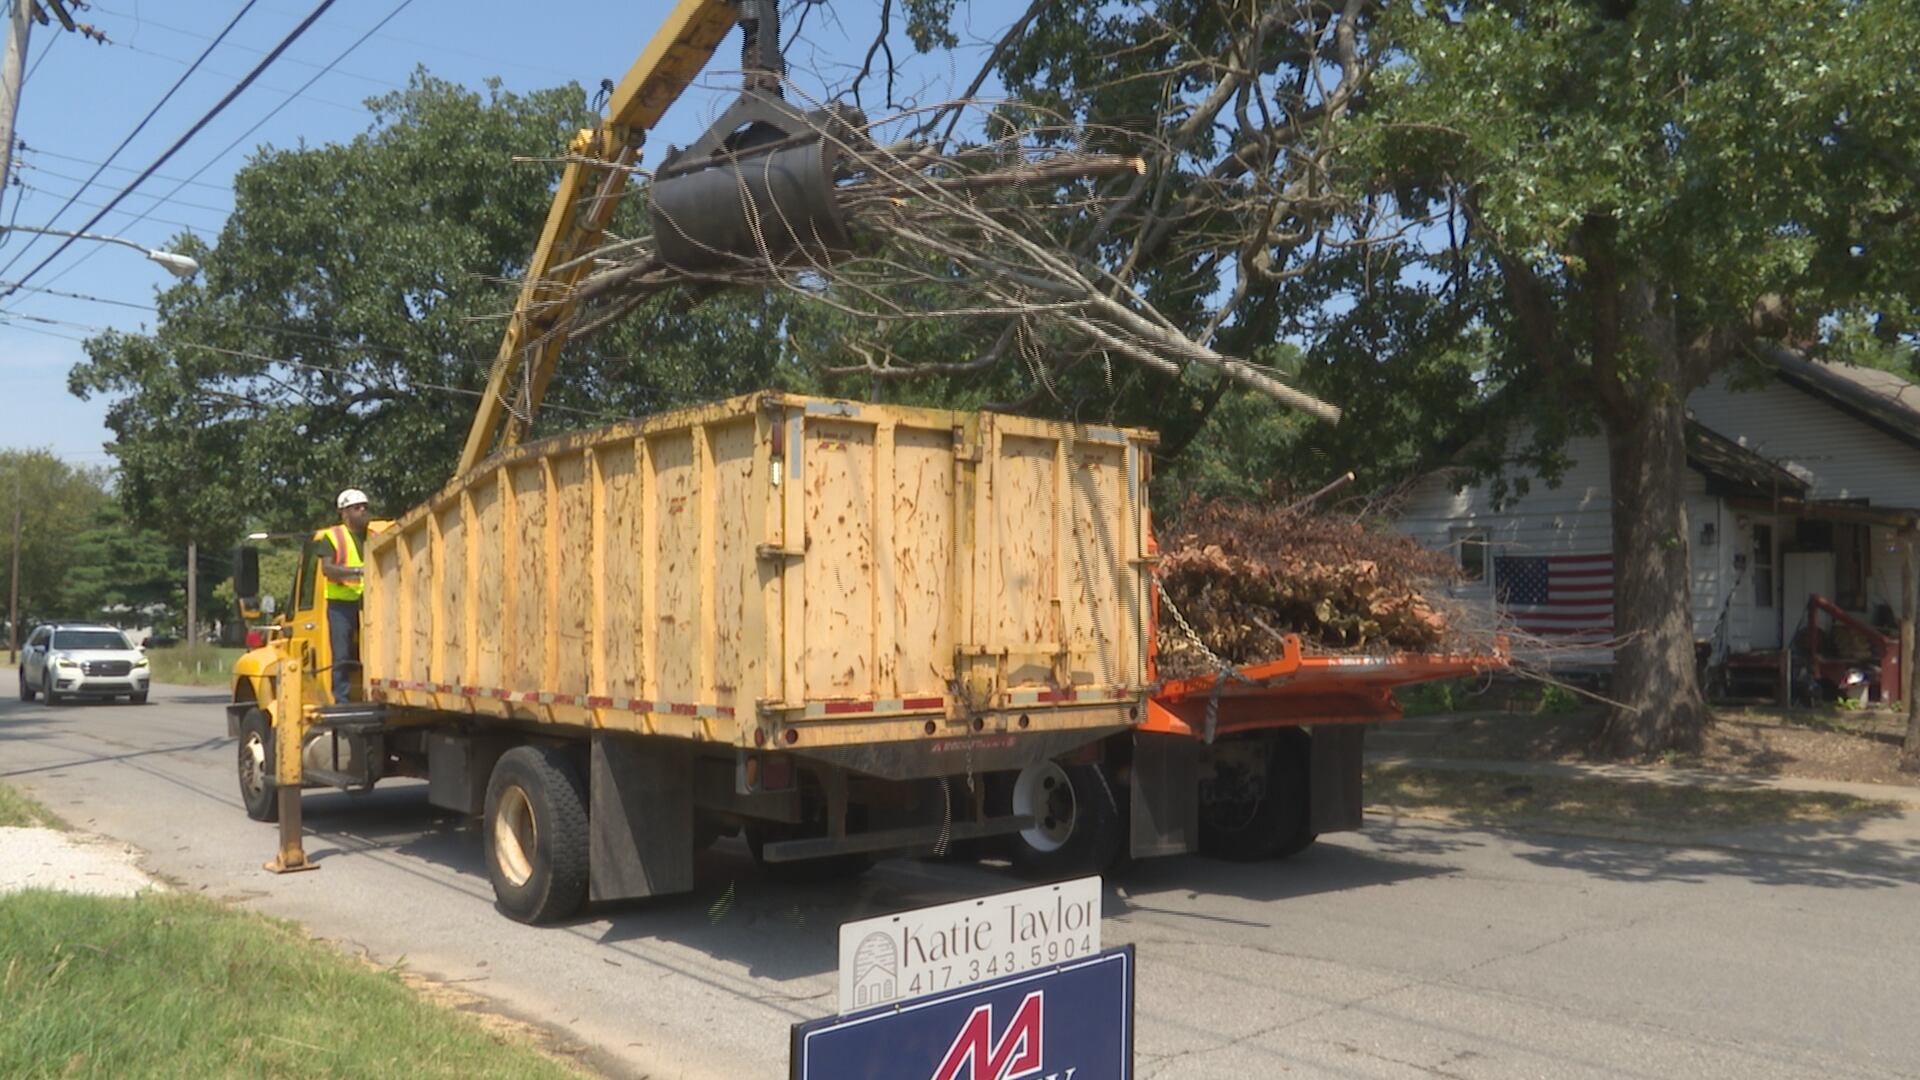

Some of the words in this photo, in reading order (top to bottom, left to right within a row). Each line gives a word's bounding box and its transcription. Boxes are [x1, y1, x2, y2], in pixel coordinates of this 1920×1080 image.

[903, 917, 993, 968] Katie
[1004, 895, 1097, 945] Taylor
[908, 934, 1093, 994] 417.343.5904
